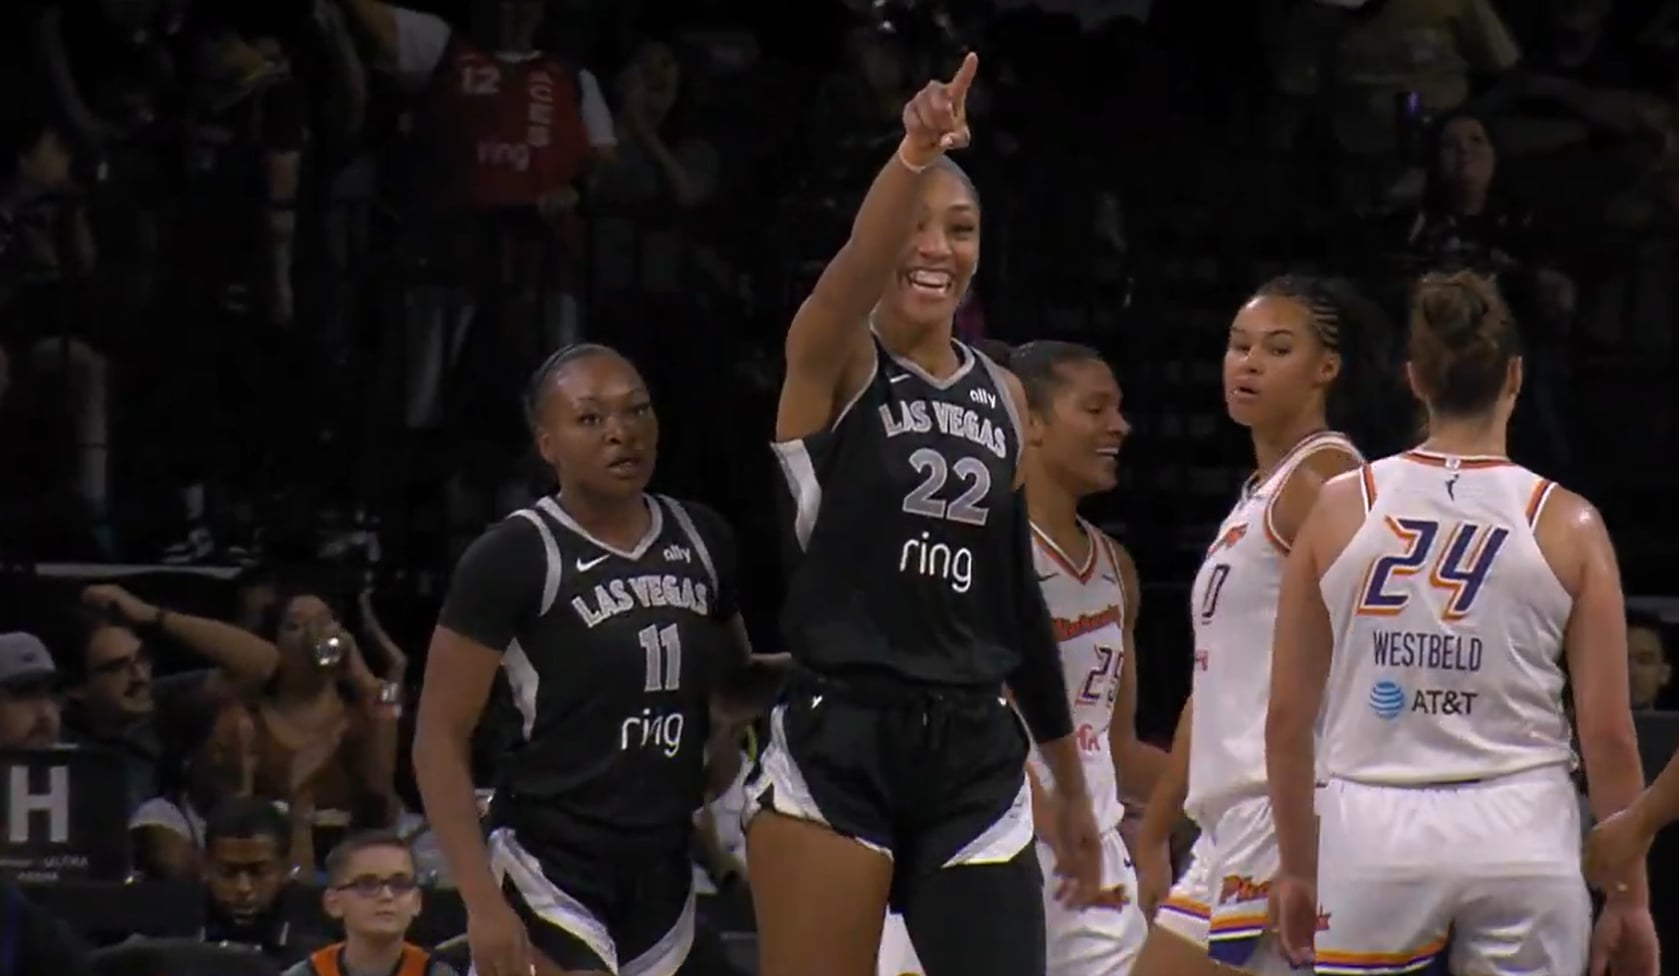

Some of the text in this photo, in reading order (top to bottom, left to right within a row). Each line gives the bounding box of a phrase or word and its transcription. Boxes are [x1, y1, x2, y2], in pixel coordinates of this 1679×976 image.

[461, 64, 502, 95] 12
[969, 388, 997, 409] ally
[878, 400, 1007, 459] LAS VEGAS
[902, 447, 992, 528] 22
[663, 543, 692, 564] ally
[899, 530, 974, 593] ring
[1356, 515, 1509, 622] 24
[571, 574, 709, 628] LAS VEGAS
[1201, 563, 1231, 625] 0
[638, 622, 682, 692] 11
[1373, 631, 1483, 672] WESTBELD
[1411, 688, 1478, 716] AT&T
[621, 707, 685, 758] ring
[9, 764, 69, 844] H
